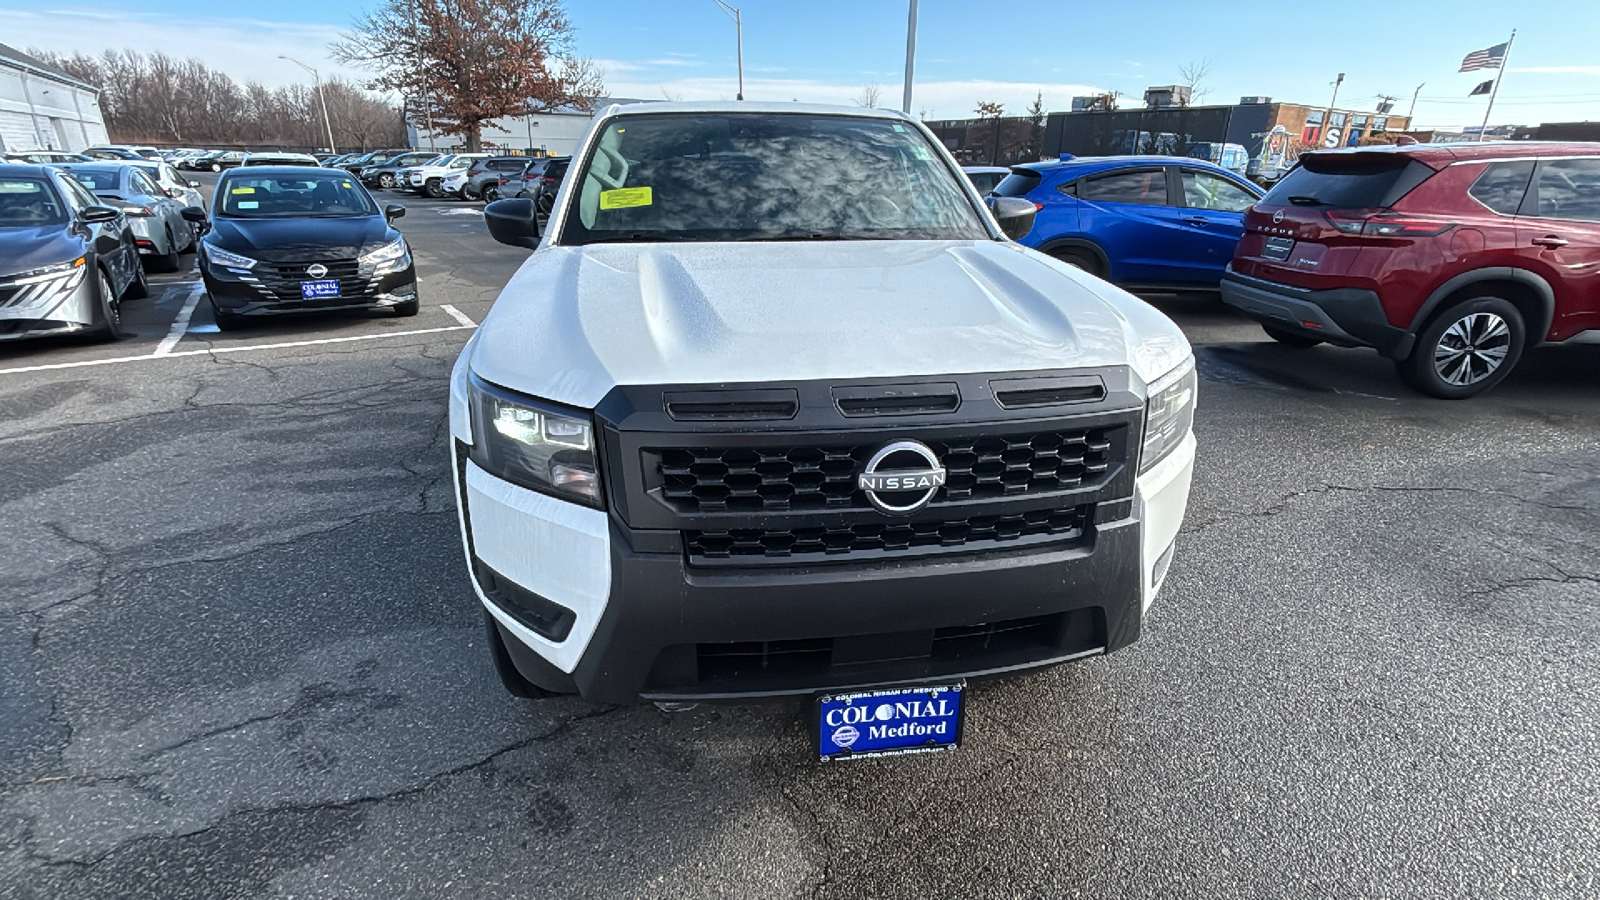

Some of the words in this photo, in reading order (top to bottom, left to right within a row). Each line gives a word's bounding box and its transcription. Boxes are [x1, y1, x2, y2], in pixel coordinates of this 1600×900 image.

[1302, 127, 1359, 148] USA
[861, 473, 944, 489] NISSAN
[835, 692, 872, 701] COLONIAL
[873, 689, 901, 698] NISSAN
[913, 686, 949, 694] MEDFORD
[826, 699, 954, 727] COLONIAL
[868, 721, 947, 740] Medford
